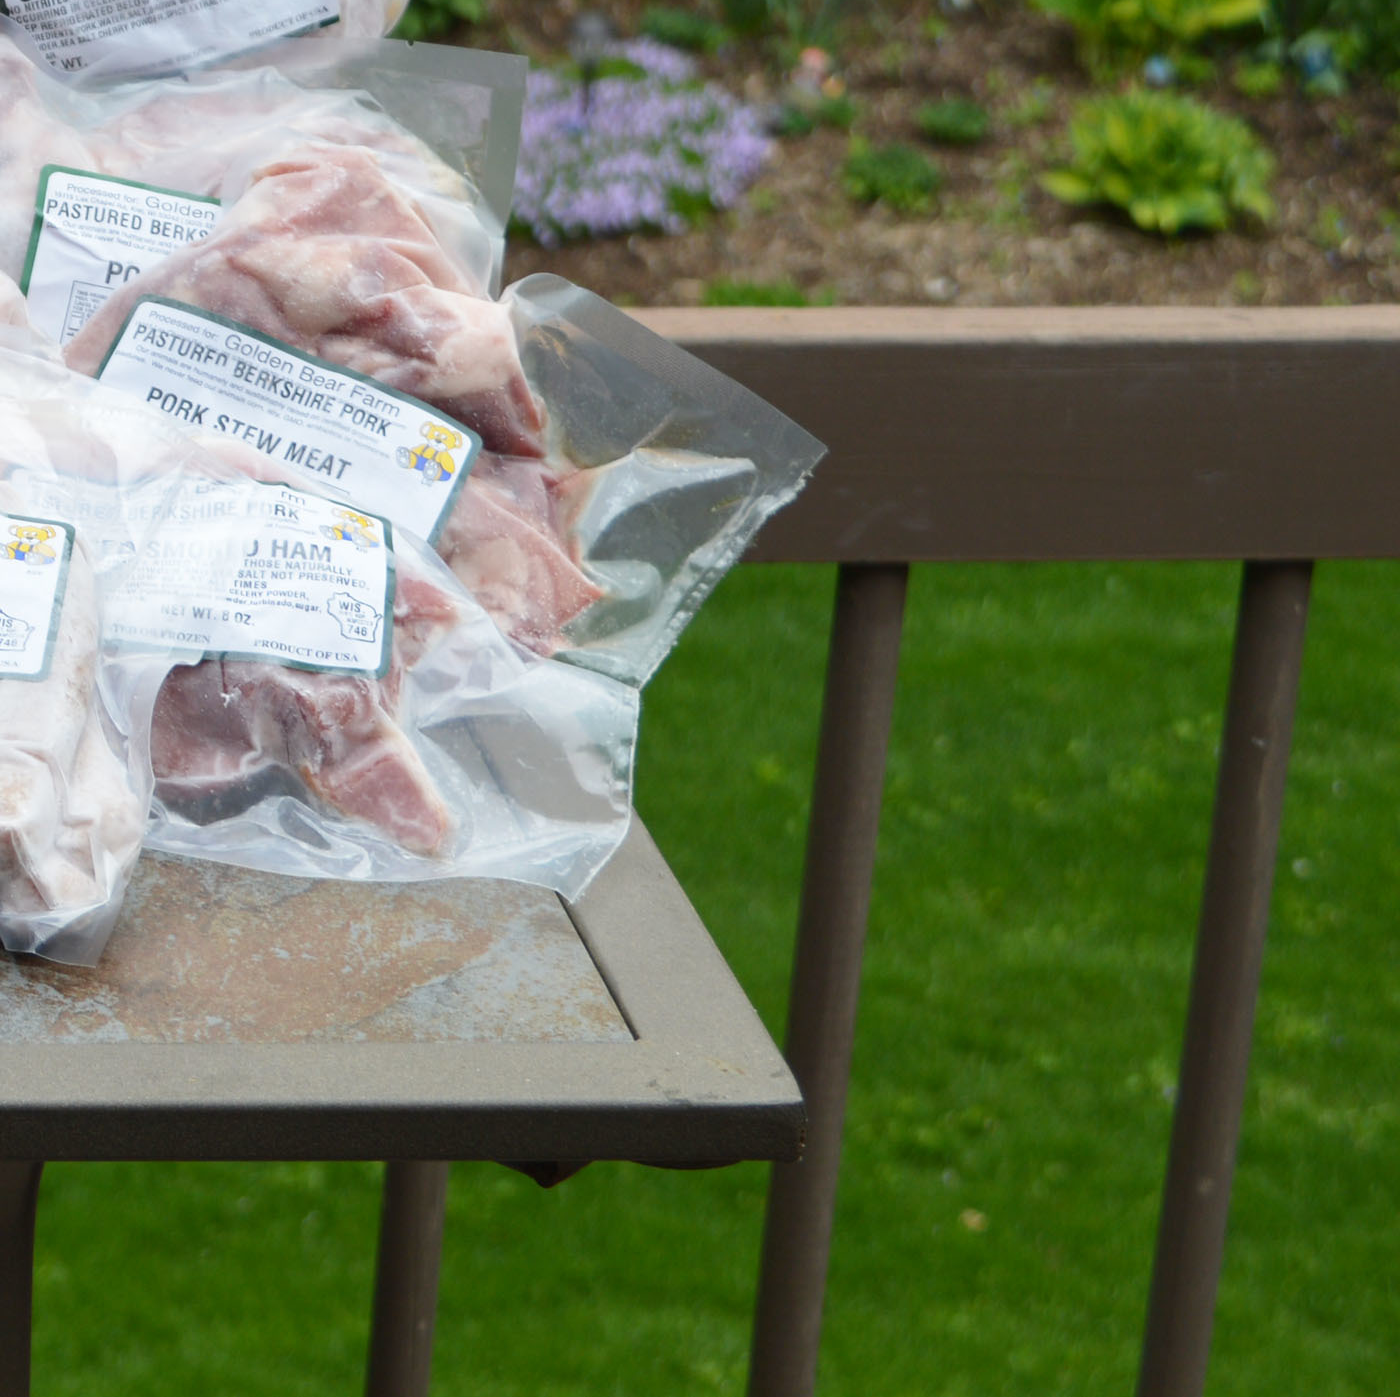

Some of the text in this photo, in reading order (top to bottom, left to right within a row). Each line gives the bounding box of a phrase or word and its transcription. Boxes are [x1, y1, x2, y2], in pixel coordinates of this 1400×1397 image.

[45, 198, 143, 231] PASTURED
[149, 218, 209, 242] BERKS
[144, 195, 215, 221] Golden
[132, 323, 393, 437] PASTURED BERKSHIRE PORK
[224, 333, 294, 374] Golden
[299, 365, 347, 393] Bear
[349, 384, 401, 418] Farm
[145, 385, 211, 426] PORK
[283, 441, 353, 480] MEAT
[271, 538, 332, 564] HAM
[237, 569, 266, 580] SALT
[270, 570, 294, 581] NOT
[243, 558, 353, 577] THOSE NATURALLY
[233, 579, 268, 590] TIMES
[192, 605, 256, 627] WT. OZ.
[347, 624, 368, 637] 746
[253, 638, 359, 663] PRODUCT USA
